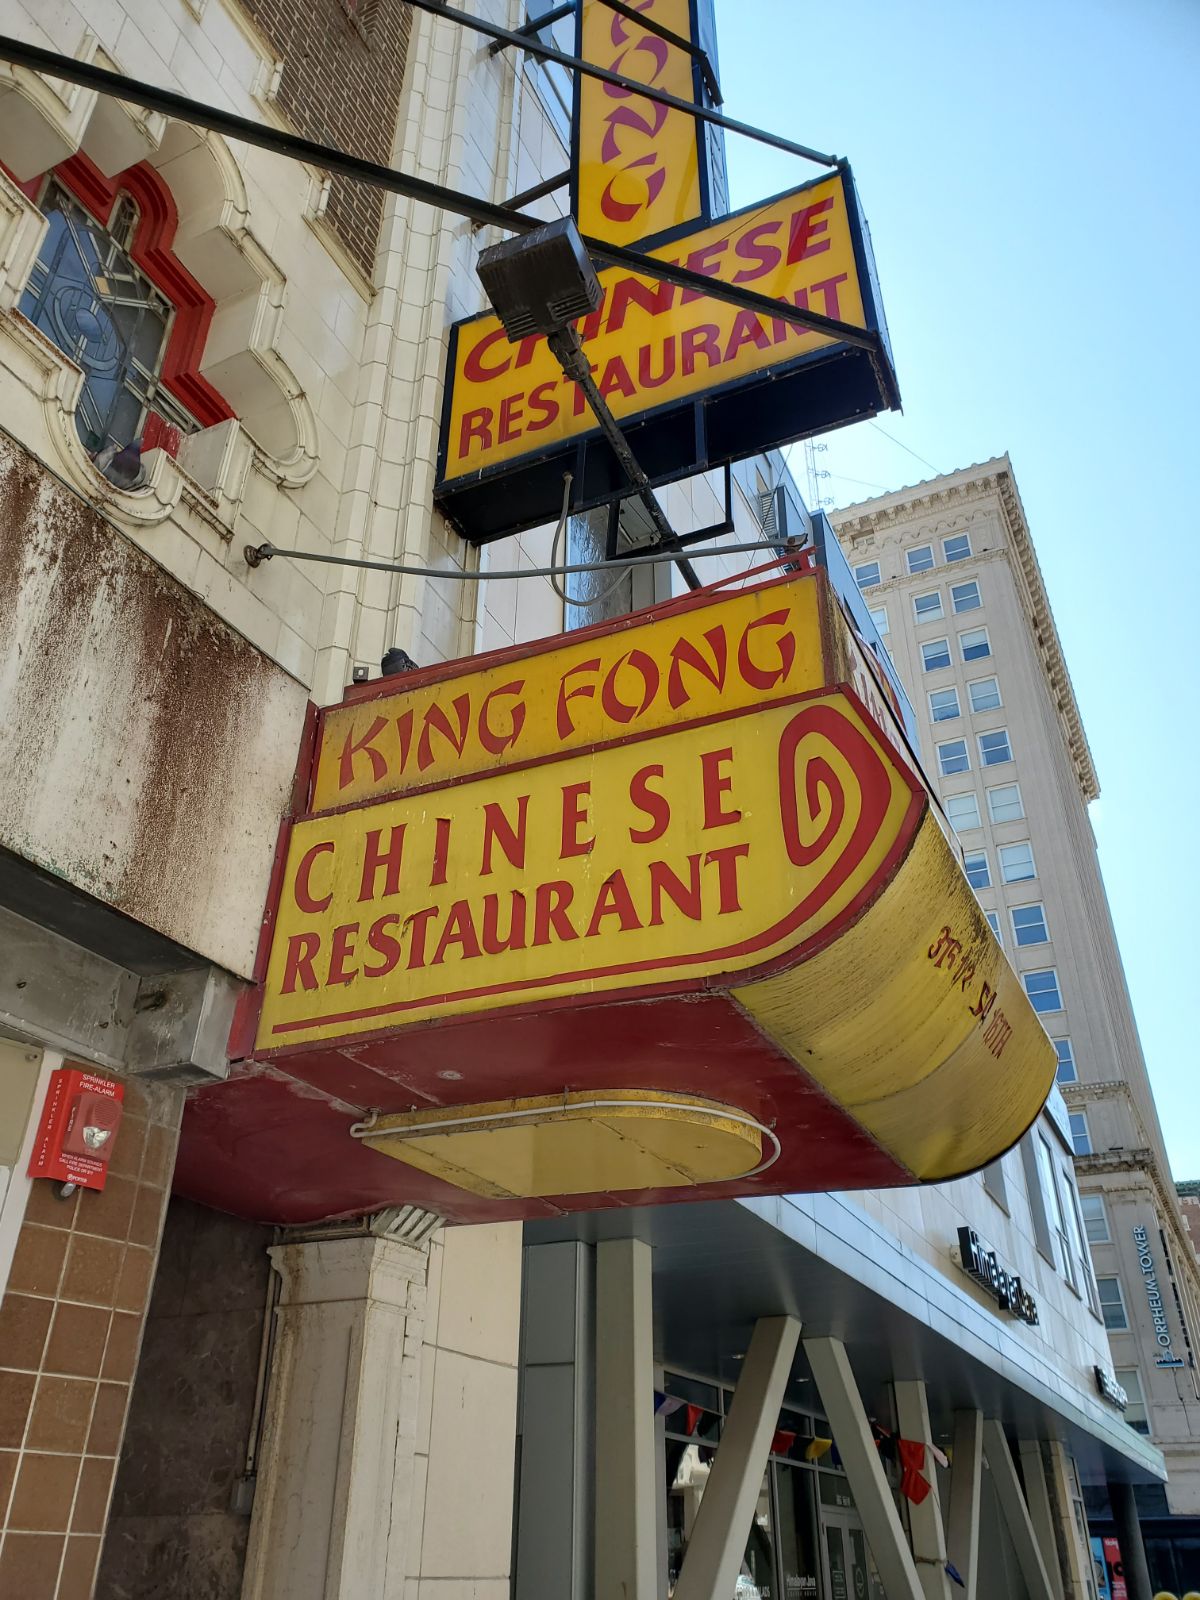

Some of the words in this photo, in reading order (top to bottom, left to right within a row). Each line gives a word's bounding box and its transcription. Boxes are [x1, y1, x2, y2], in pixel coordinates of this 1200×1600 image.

[337, 679, 526, 790] KING
[556, 607, 796, 740] FONG
[293, 747, 742, 914] CHINESE
[280, 843, 750, 994] RESTAURANT
[83, 1073, 116, 1089] SPRINKLER
[1133, 1225, 1153, 1275] TOWER
[1145, 1272, 1171, 1347] ORPHEUM
